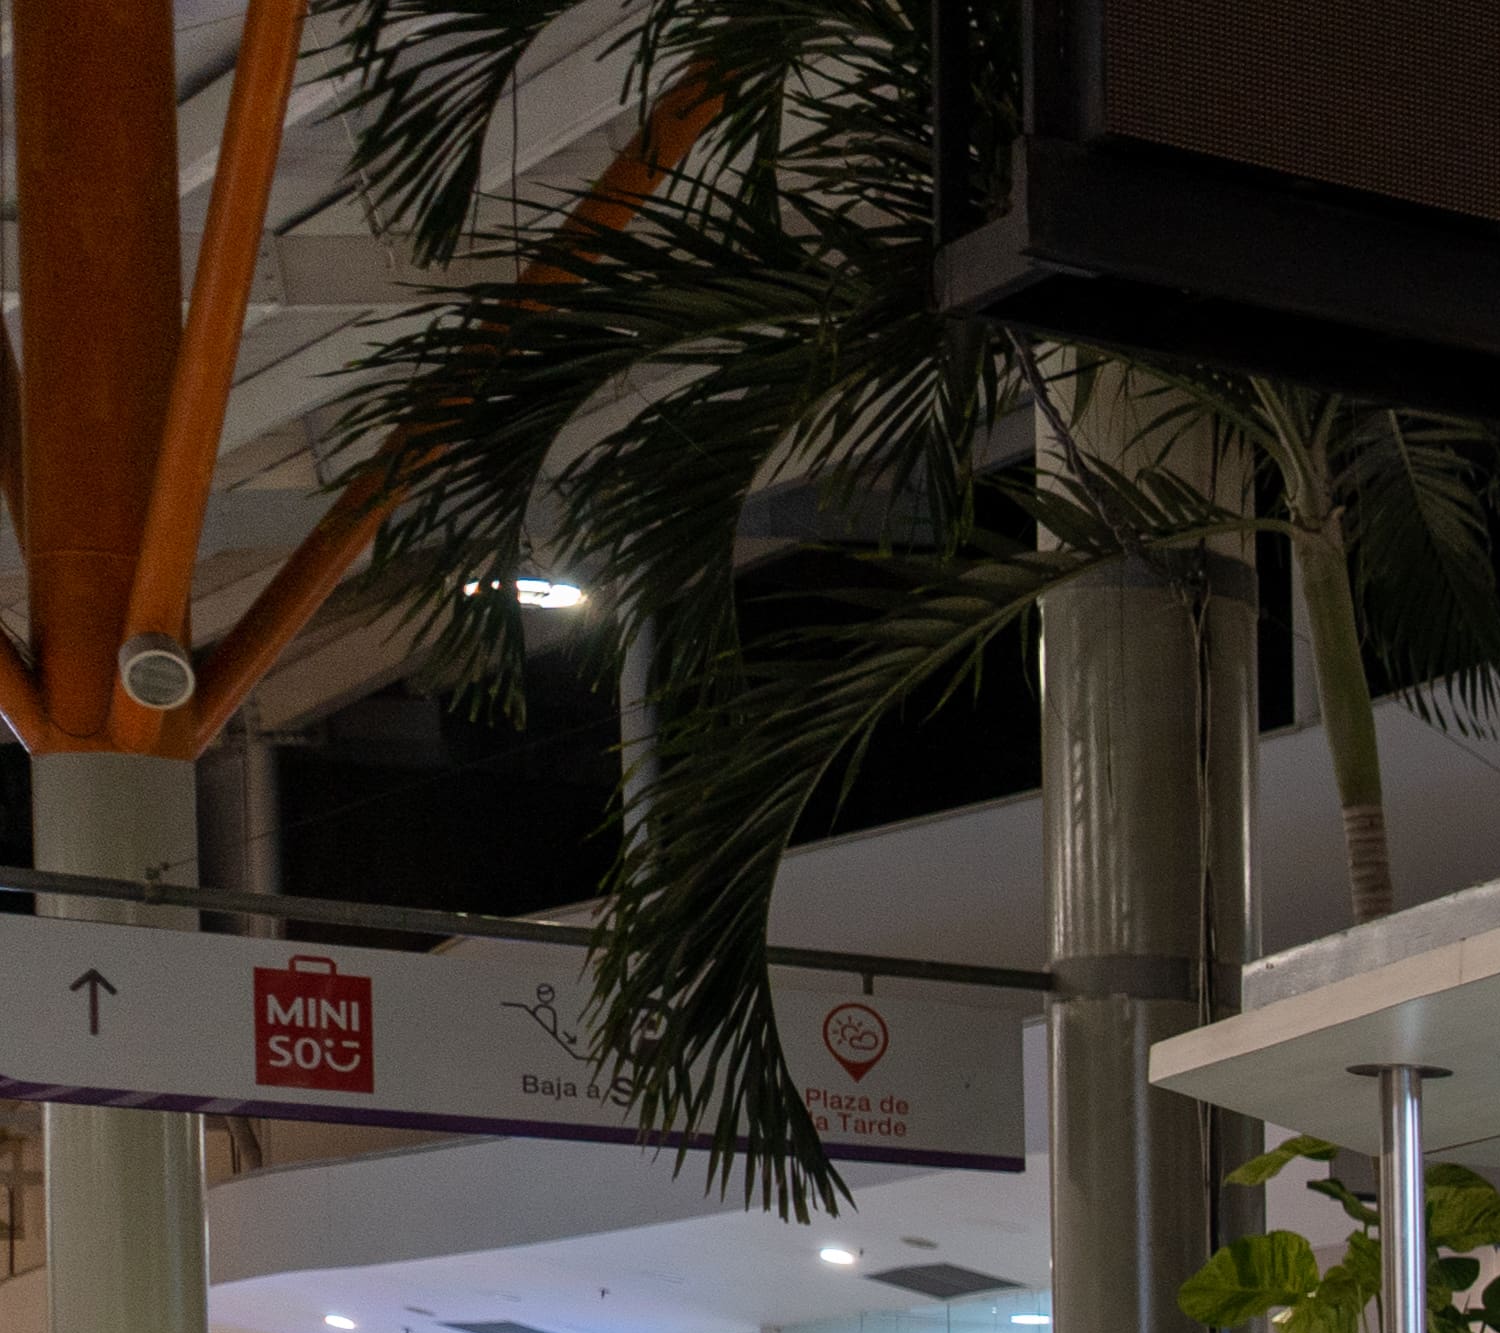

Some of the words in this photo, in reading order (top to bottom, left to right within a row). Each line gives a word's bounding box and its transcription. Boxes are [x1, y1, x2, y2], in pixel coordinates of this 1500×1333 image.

[266, 994, 360, 1032] MINI
[522, 1074, 577, 1100] Baja
[806, 1088, 869, 1114] Plaza
[879, 1094, 908, 1116] de
[839, 1113, 906, 1136] Tarde
